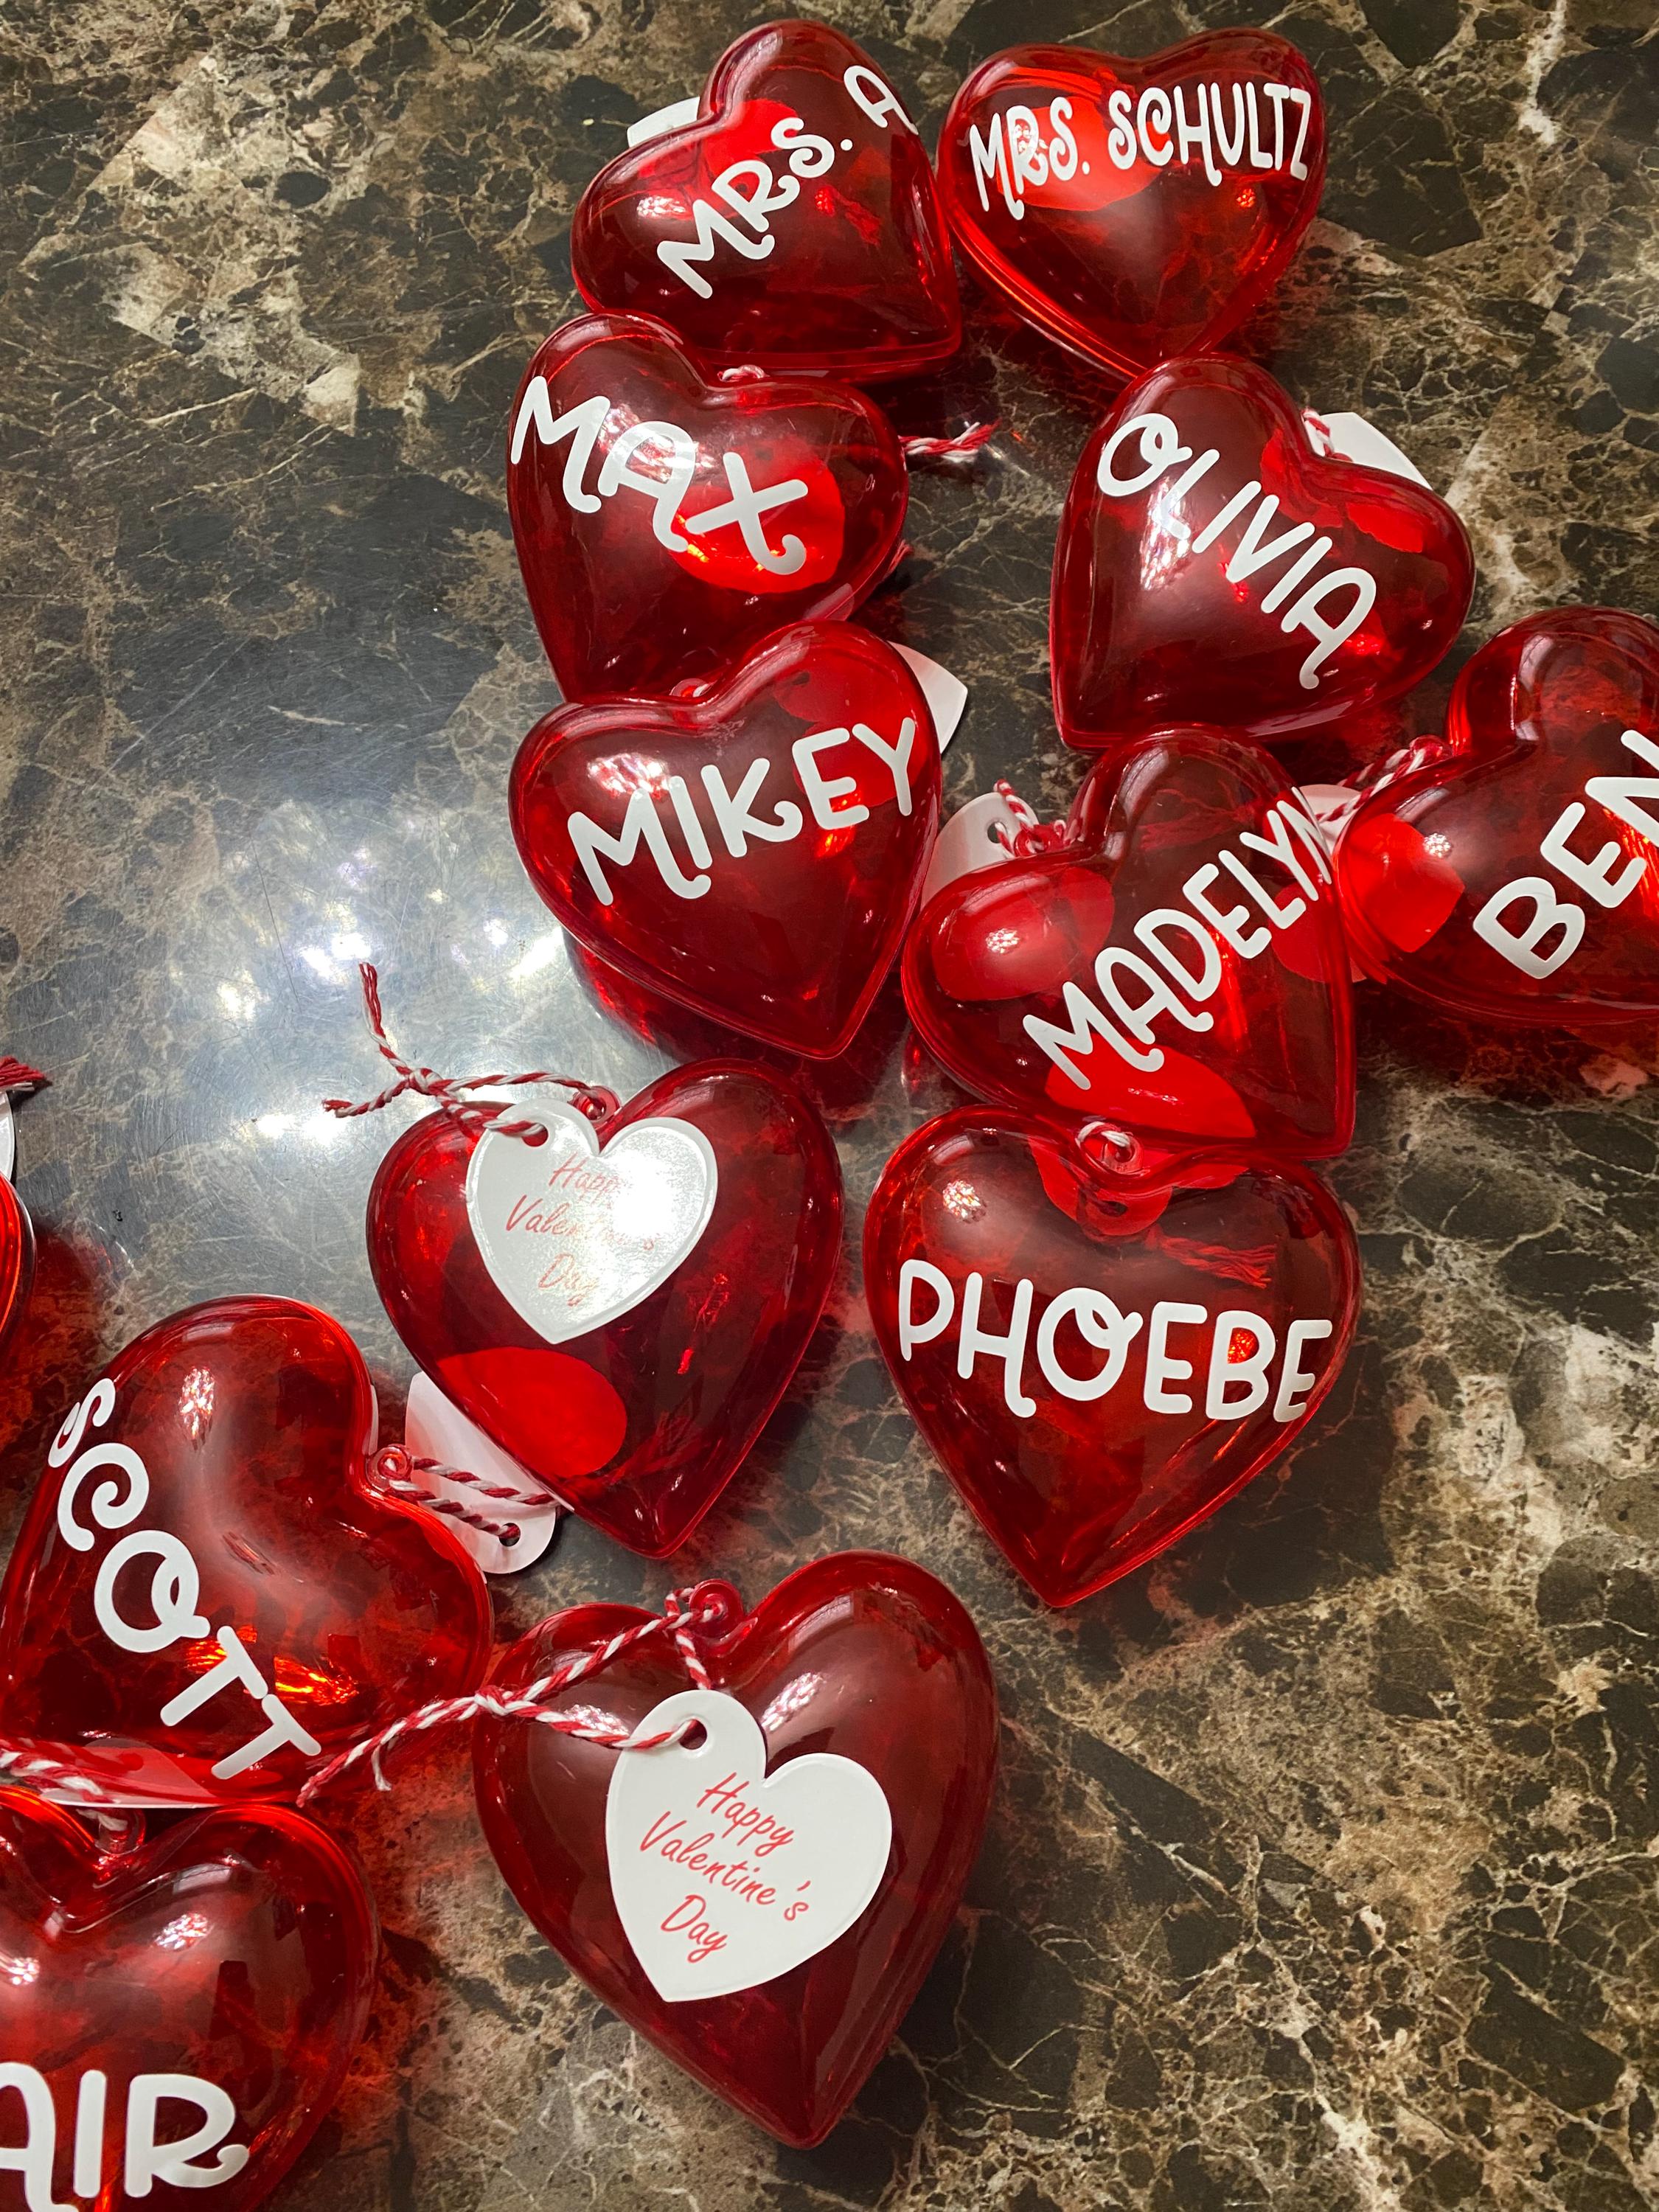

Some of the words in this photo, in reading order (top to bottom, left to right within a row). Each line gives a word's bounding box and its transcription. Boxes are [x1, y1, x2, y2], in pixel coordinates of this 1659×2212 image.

[656, 116, 854, 299] MRS.
[844, 65, 919, 136] A
[969, 105, 1090, 220] MRS.
[1107, 81, 1312, 187] SCHULTZ
[510, 376, 809, 575] MAX
[1096, 413, 1377, 689] OLIVIA
[567, 717, 917, 906] MIKEY
[1472, 728, 1659, 979] BEN
[1023, 786, 1332, 1091] MADELYN
[548, 1151, 623, 1209] Happ
[898, 1259, 1332, 1422] PHOEBE
[47, 1377, 321, 1781] SCOTT
[640, 1811, 812, 1921] Valentine's
[697, 1772, 794, 1857] Happy
[660, 1894, 728, 1964] Day
